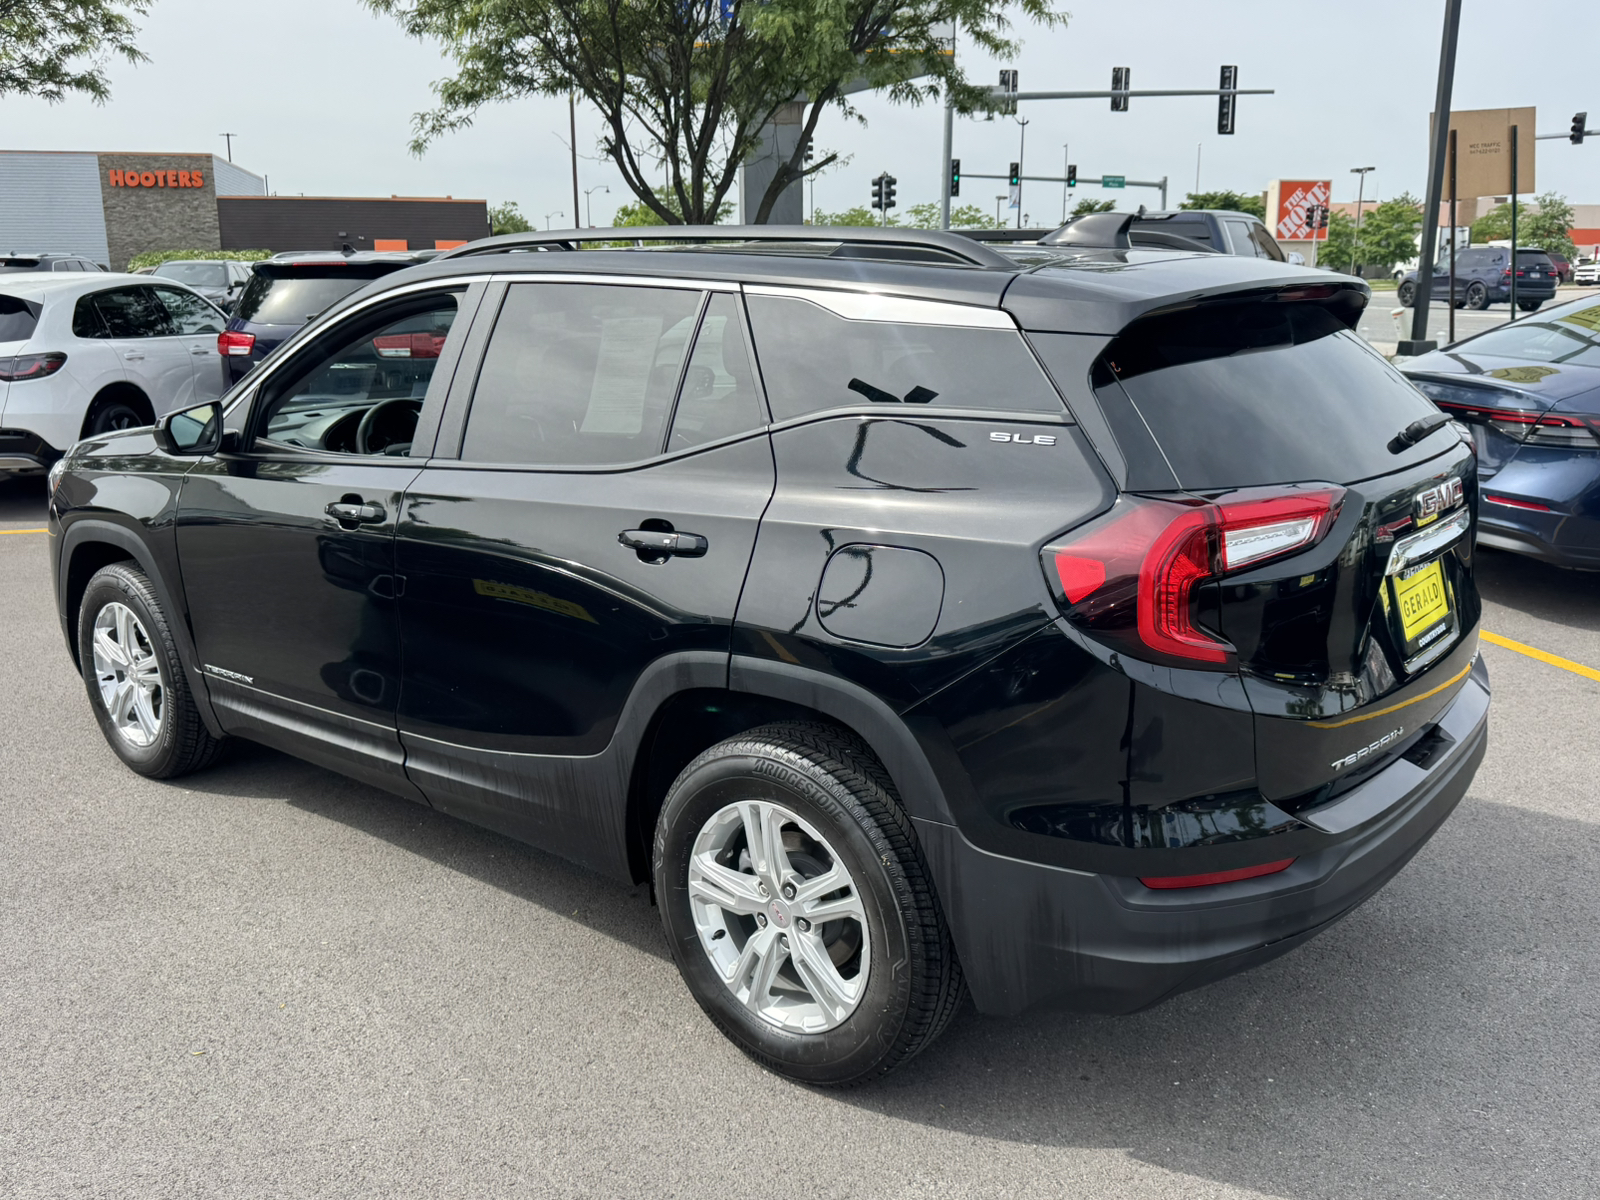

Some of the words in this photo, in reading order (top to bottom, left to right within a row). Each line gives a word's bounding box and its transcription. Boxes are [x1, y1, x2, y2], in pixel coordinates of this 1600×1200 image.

[109, 169, 204, 188] HOOTERS
[1277, 181, 1330, 239] HOME
[1283, 187, 1305, 210] THE
[990, 431, 1057, 446] SLE
[1416, 476, 1463, 518] GMC
[1403, 582, 1439, 618] GERALD
[1330, 726, 1404, 771] TERRAIN
[752, 758, 846, 823] BRIDGESTONE
